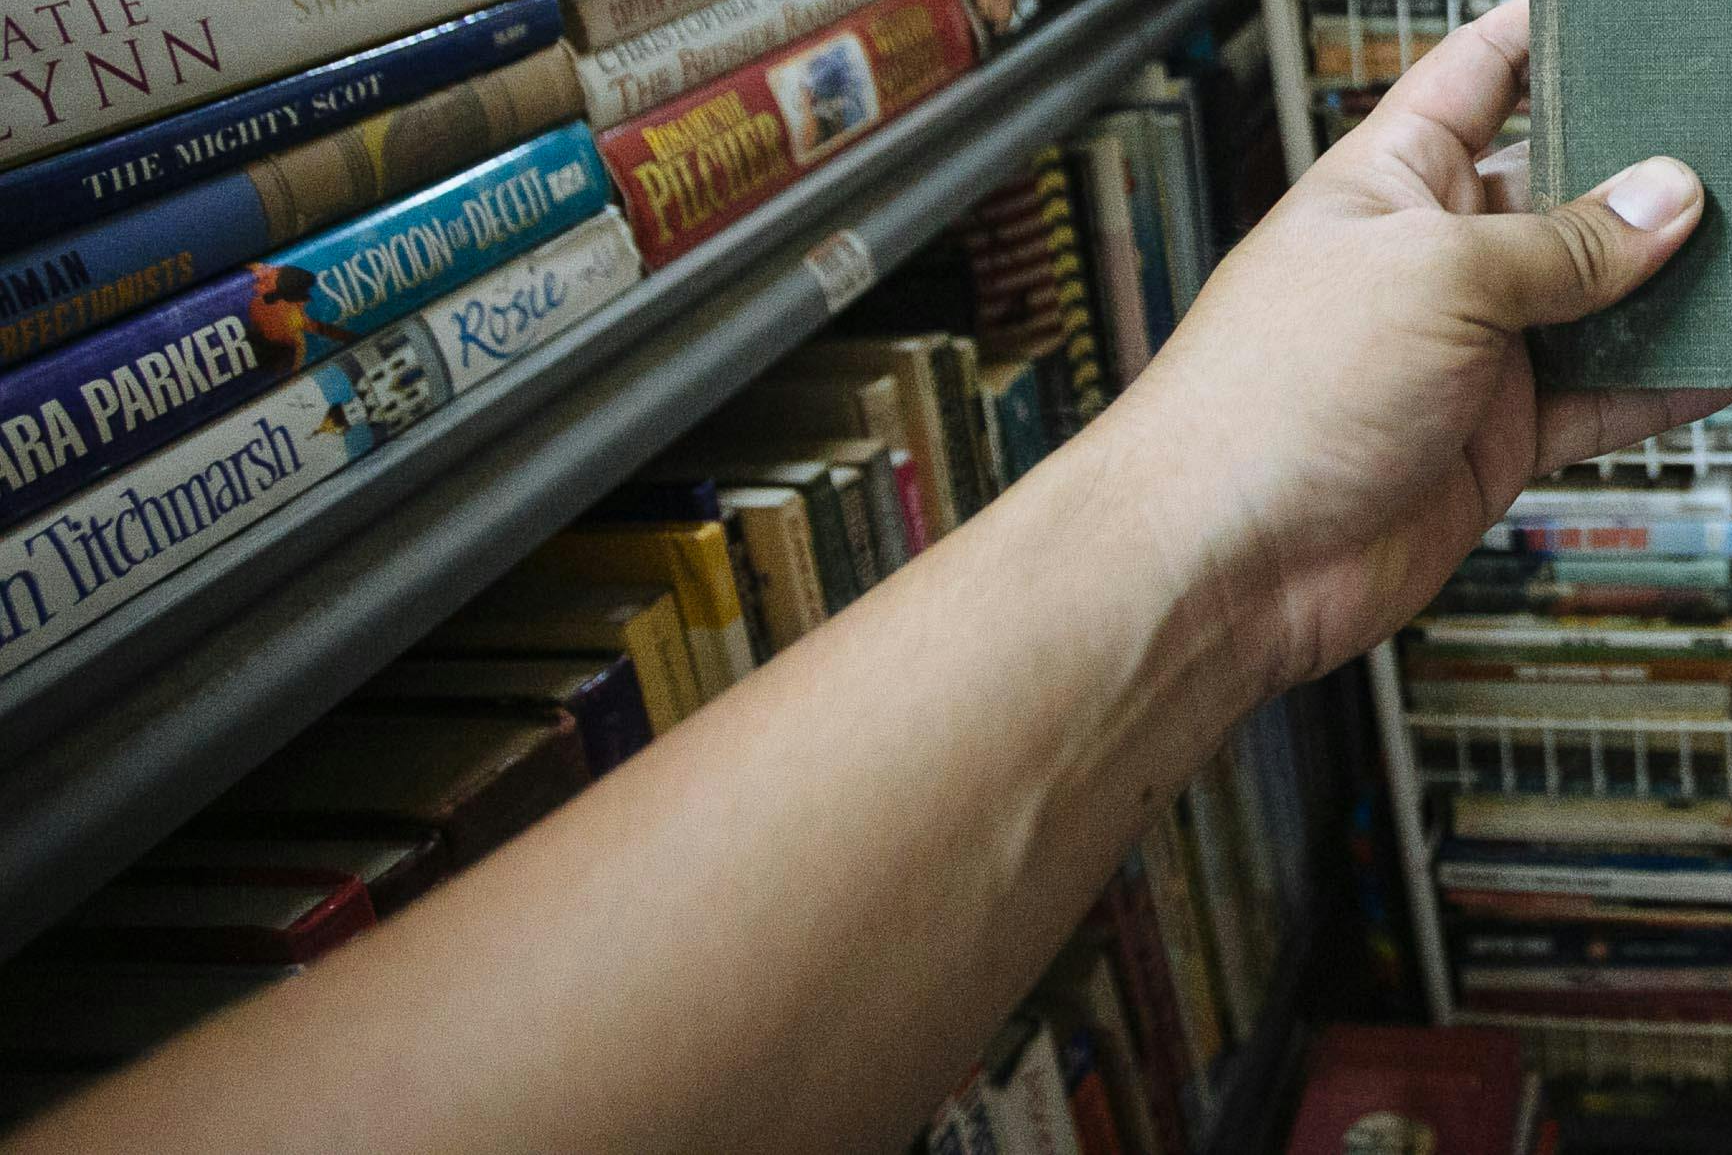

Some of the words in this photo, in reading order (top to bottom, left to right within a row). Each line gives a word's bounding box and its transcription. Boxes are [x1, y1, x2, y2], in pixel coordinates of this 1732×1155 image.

[80, 151, 167, 201] THE
[173, 104, 302, 167] MIGHTY
[310, 71, 386, 118] SCOT
[315, 224, 456, 328] SUSPICION
[467, 170, 550, 244] DECEIT
[80, 313, 260, 446] PARKER
[450, 268, 569, 372] Rosie
[25, 415, 303, 607] Titchmarsh
